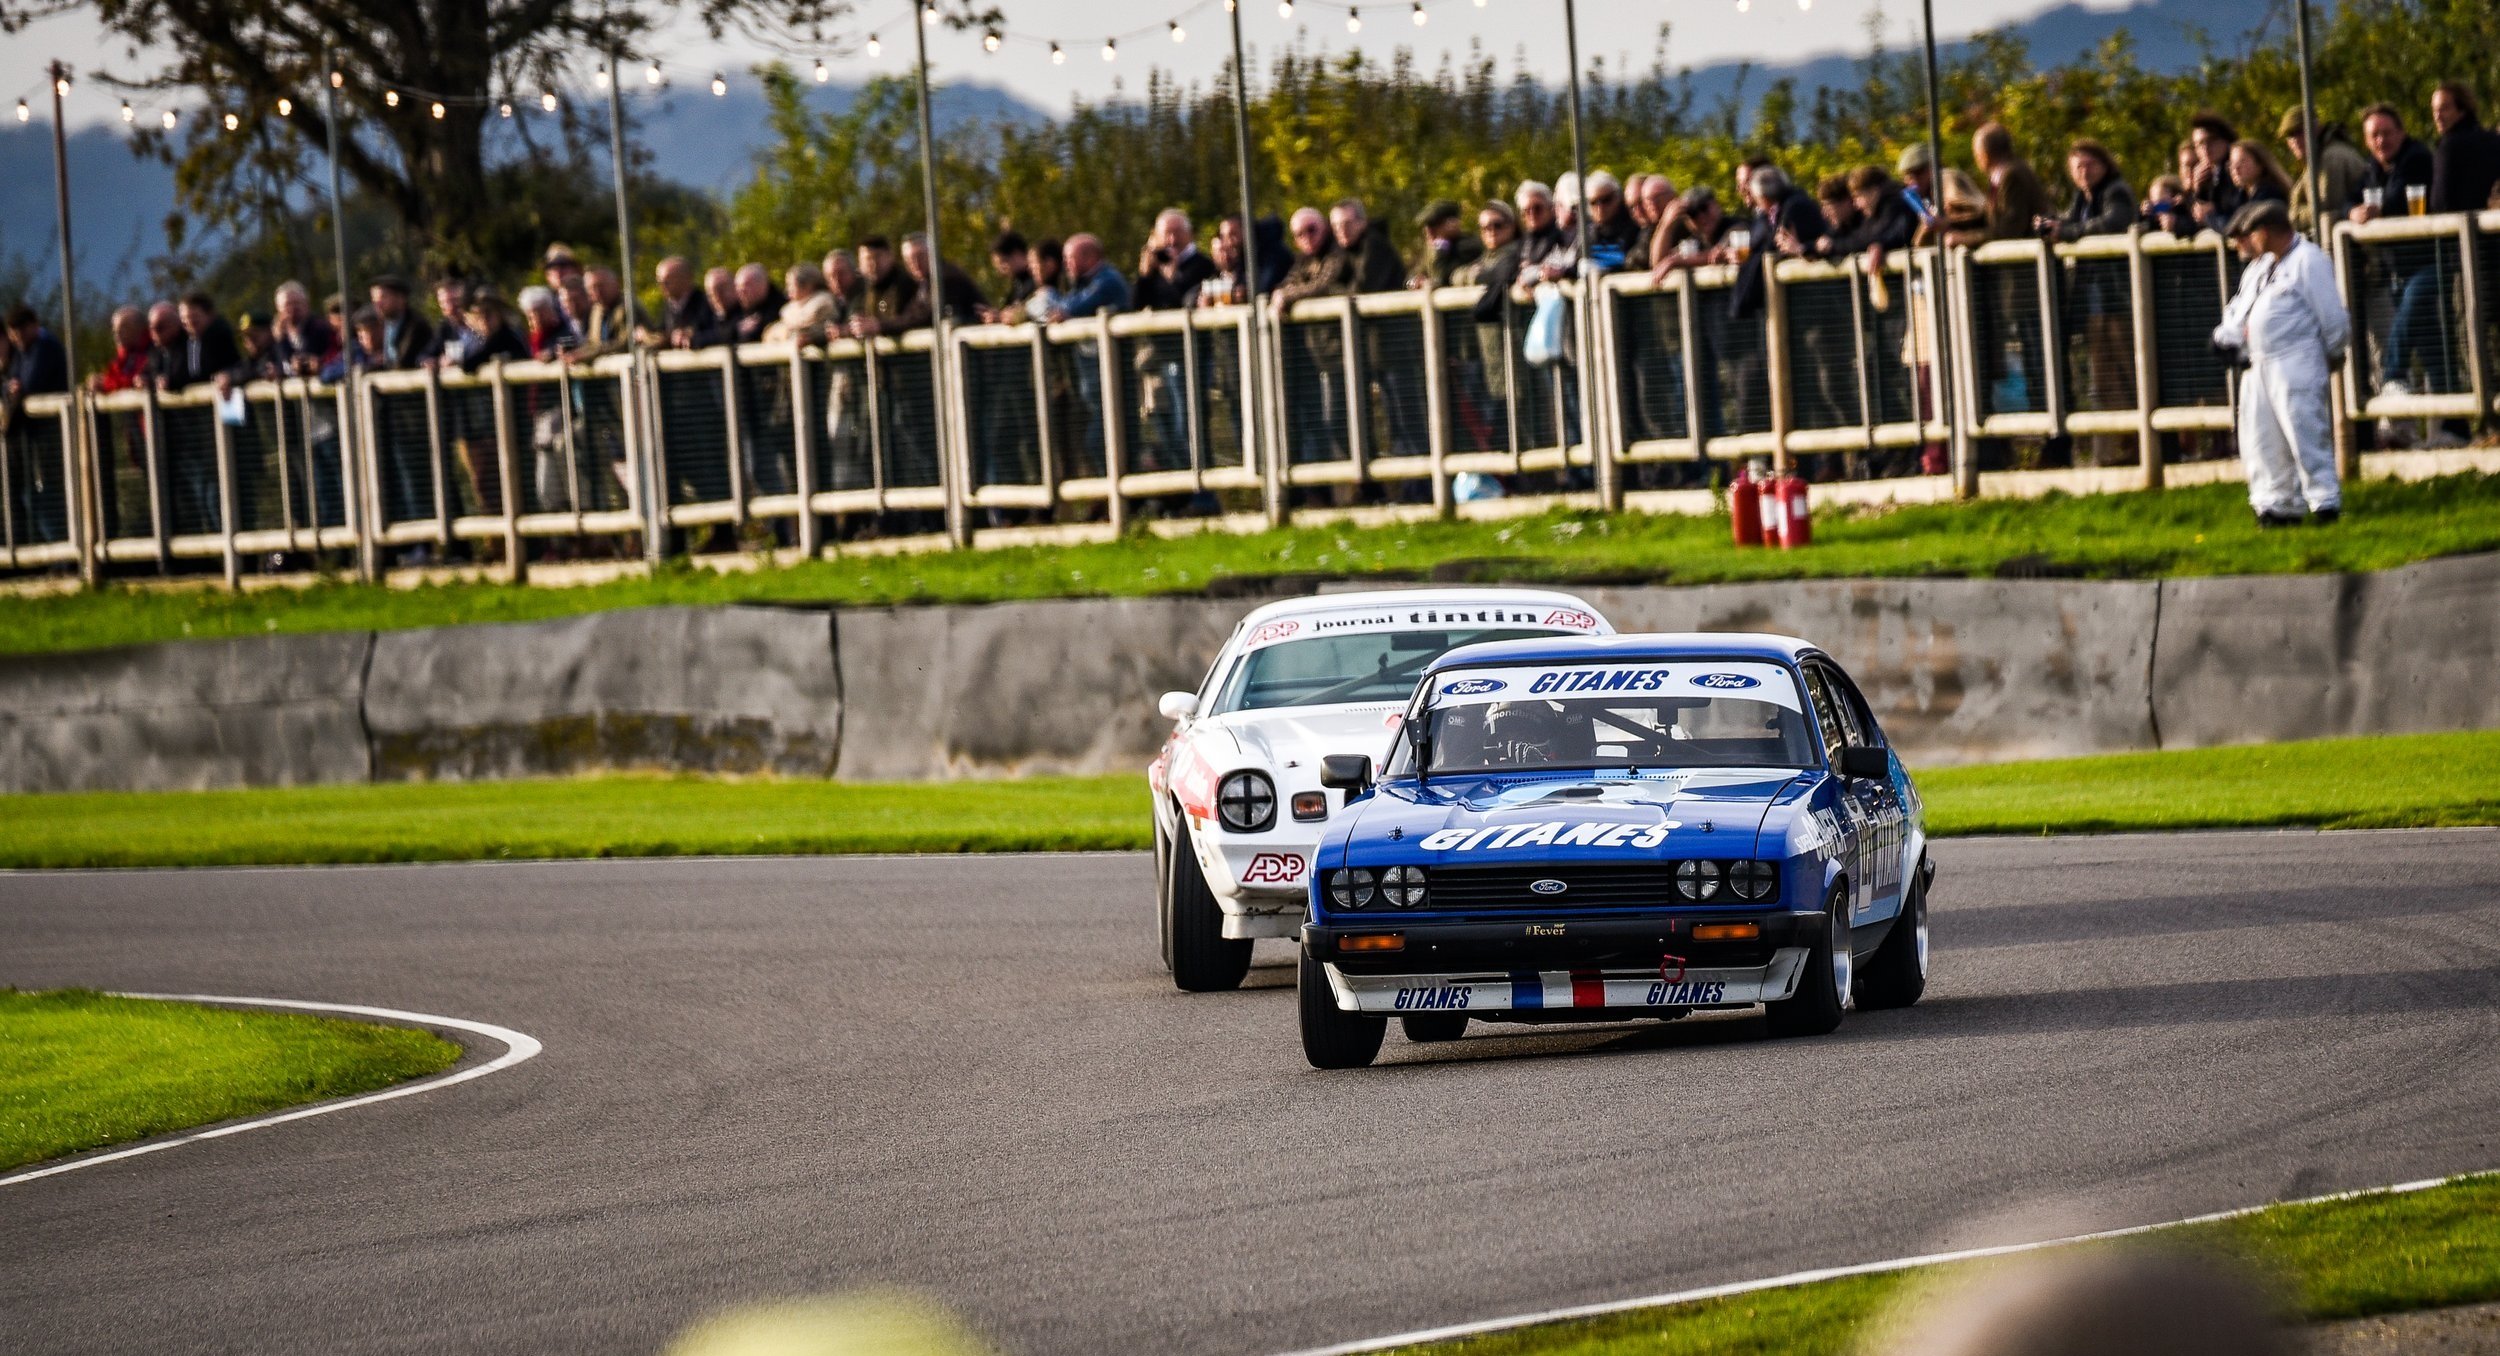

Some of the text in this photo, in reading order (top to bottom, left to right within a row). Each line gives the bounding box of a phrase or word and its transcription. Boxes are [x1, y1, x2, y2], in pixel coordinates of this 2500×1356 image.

[1312, 610, 1537, 632] journal tintin
[1543, 610, 1596, 629] ADP
[1247, 620, 1300, 646] ADP
[1451, 680, 1493, 694] Ford
[1528, 669, 1670, 695] GITANES
[1704, 673, 1746, 689] Ford
[1419, 820, 1683, 851] GITANES
[1241, 852, 1306, 882] ADP
[1538, 881, 1560, 892] Ford
[1525, 924, 1566, 936] #Fever
[1393, 986, 1473, 1010] GITANES
[1645, 981, 1726, 1005] GITANES
